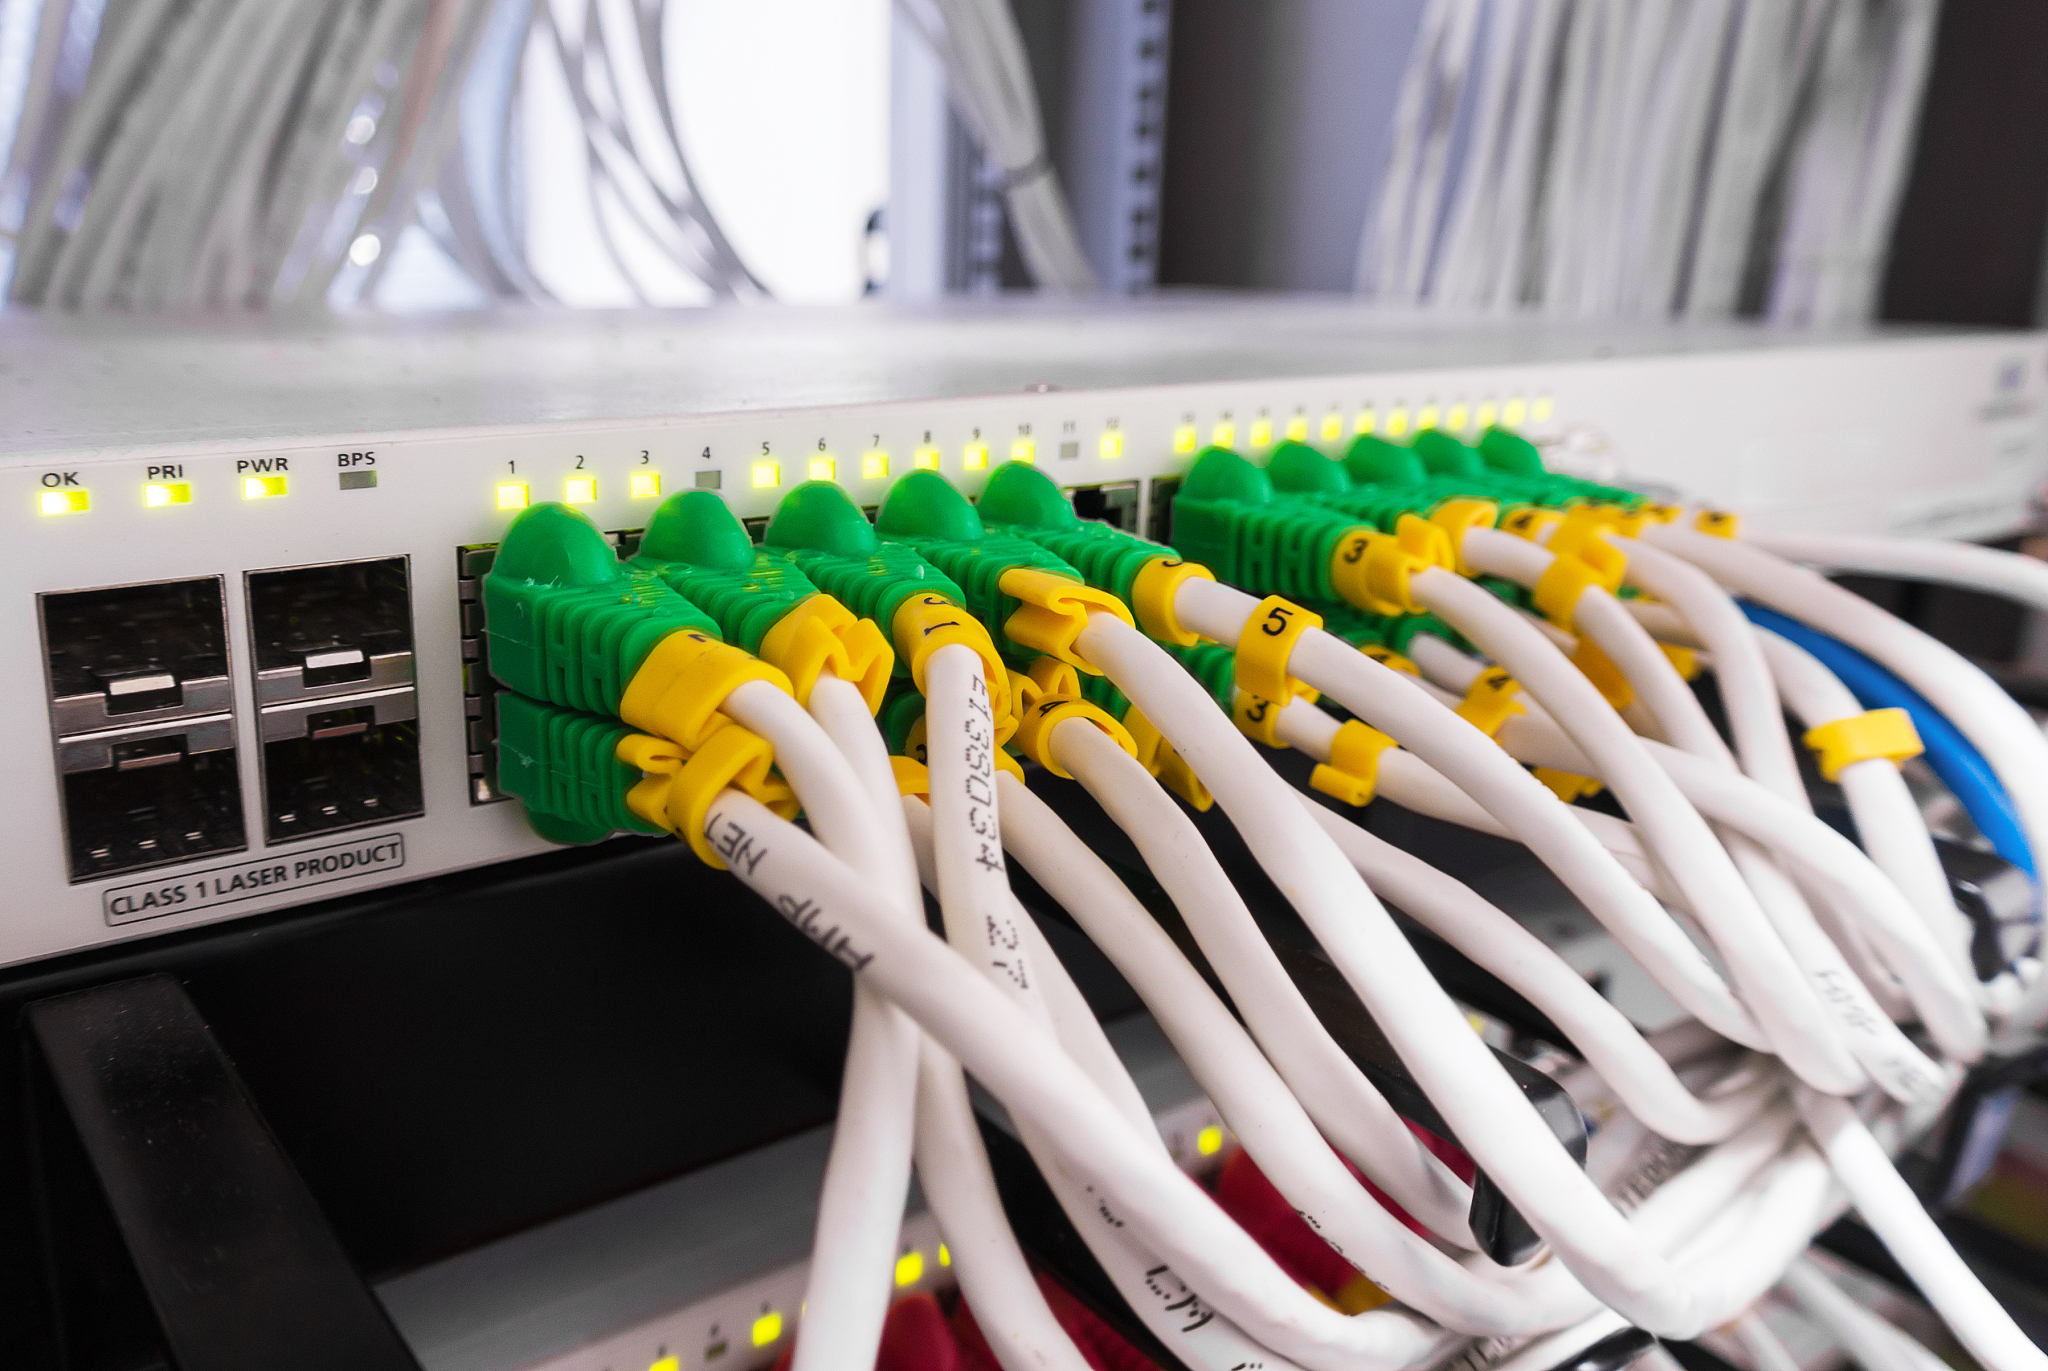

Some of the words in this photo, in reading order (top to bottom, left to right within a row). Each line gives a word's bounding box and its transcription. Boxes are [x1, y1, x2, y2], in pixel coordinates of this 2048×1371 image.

[41, 471, 79, 488] OK
[147, 464, 183, 480] PRI
[236, 457, 289, 474] PWR
[337, 451, 376, 468] BPS
[508, 460, 515, 474] 1
[575, 454, 584, 470] 2
[641, 450, 649, 465] 3
[702, 446, 711, 459] 4
[762, 441, 770, 456] 5
[818, 437, 827, 452] 6
[873, 433, 880, 447] 7
[923, 430, 932, 444] 8
[972, 426, 981, 440] 9
[1018, 423, 1032, 436] 10
[1062, 420, 1076, 433] 11
[1343, 538, 1368, 564] 3
[1262, 607, 1294, 636] 5
[1246, 694, 1269, 722] 3
[704, 812, 767, 876] NET
[110, 885, 188, 916] CLASS
[194, 880, 207, 900] 1
[215, 864, 288, 896] LASER
[294, 842, 399, 881] PRODUCT
[776, 894, 874, 972] AMP
